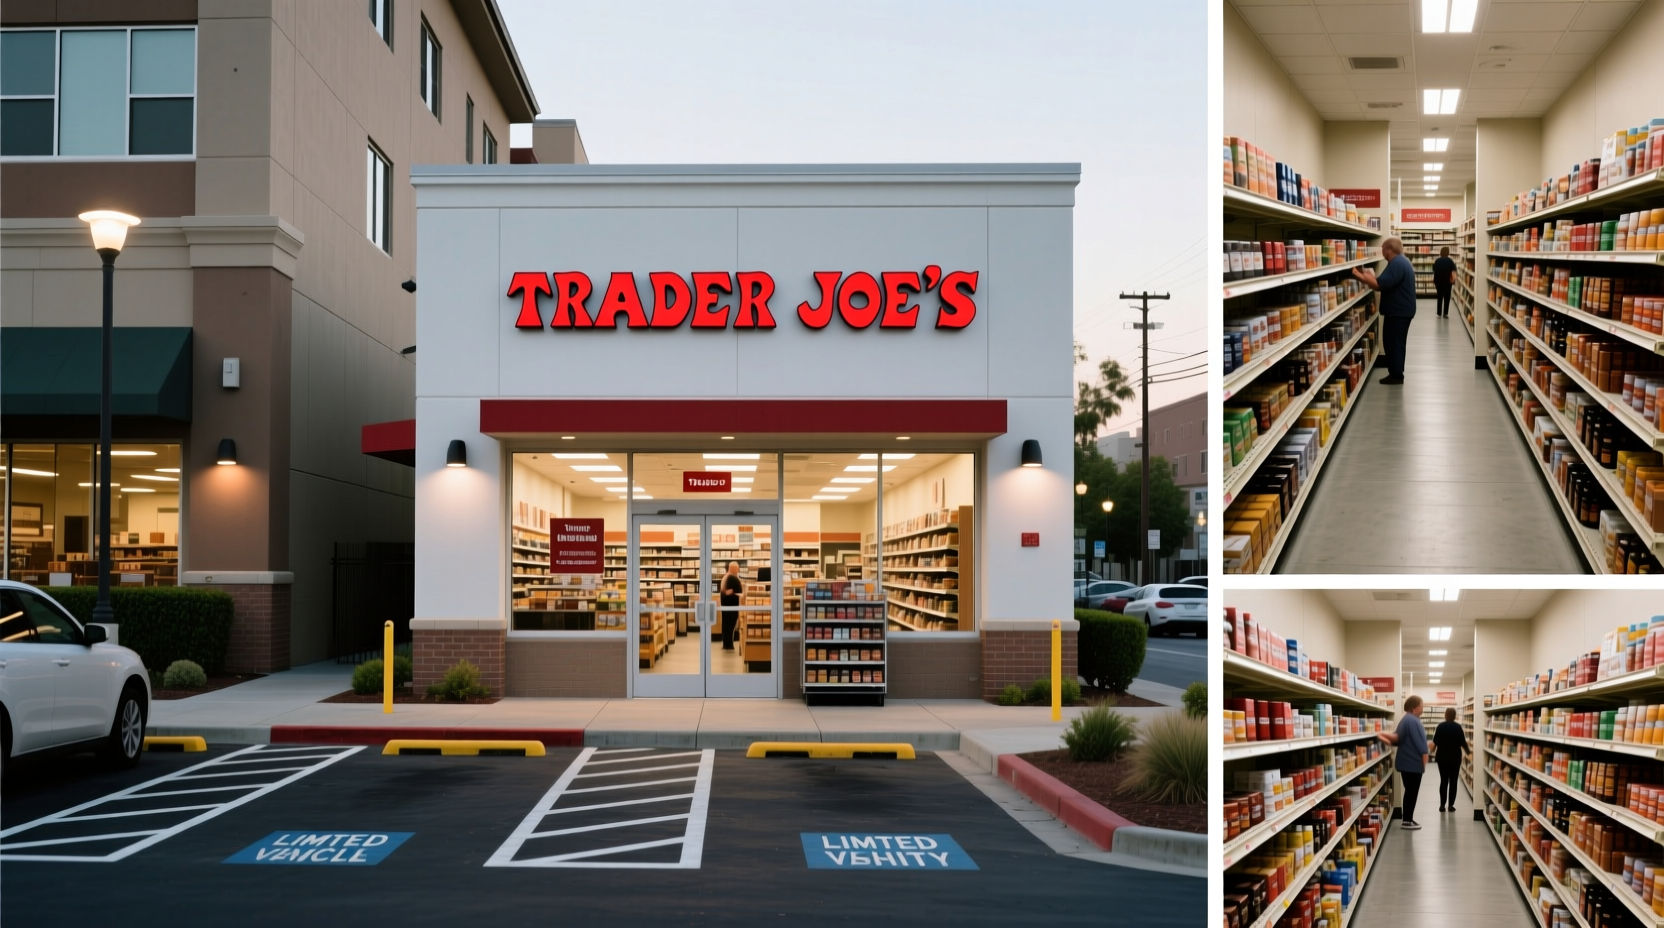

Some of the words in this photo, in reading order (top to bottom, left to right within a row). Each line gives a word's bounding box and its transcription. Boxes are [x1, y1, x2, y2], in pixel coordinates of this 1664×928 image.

[507, 271, 777, 330] TRADER
[797, 265, 979, 330] JOE'S
[272, 834, 389, 847] LIMTED
[821, 835, 938, 850] LIMTED
